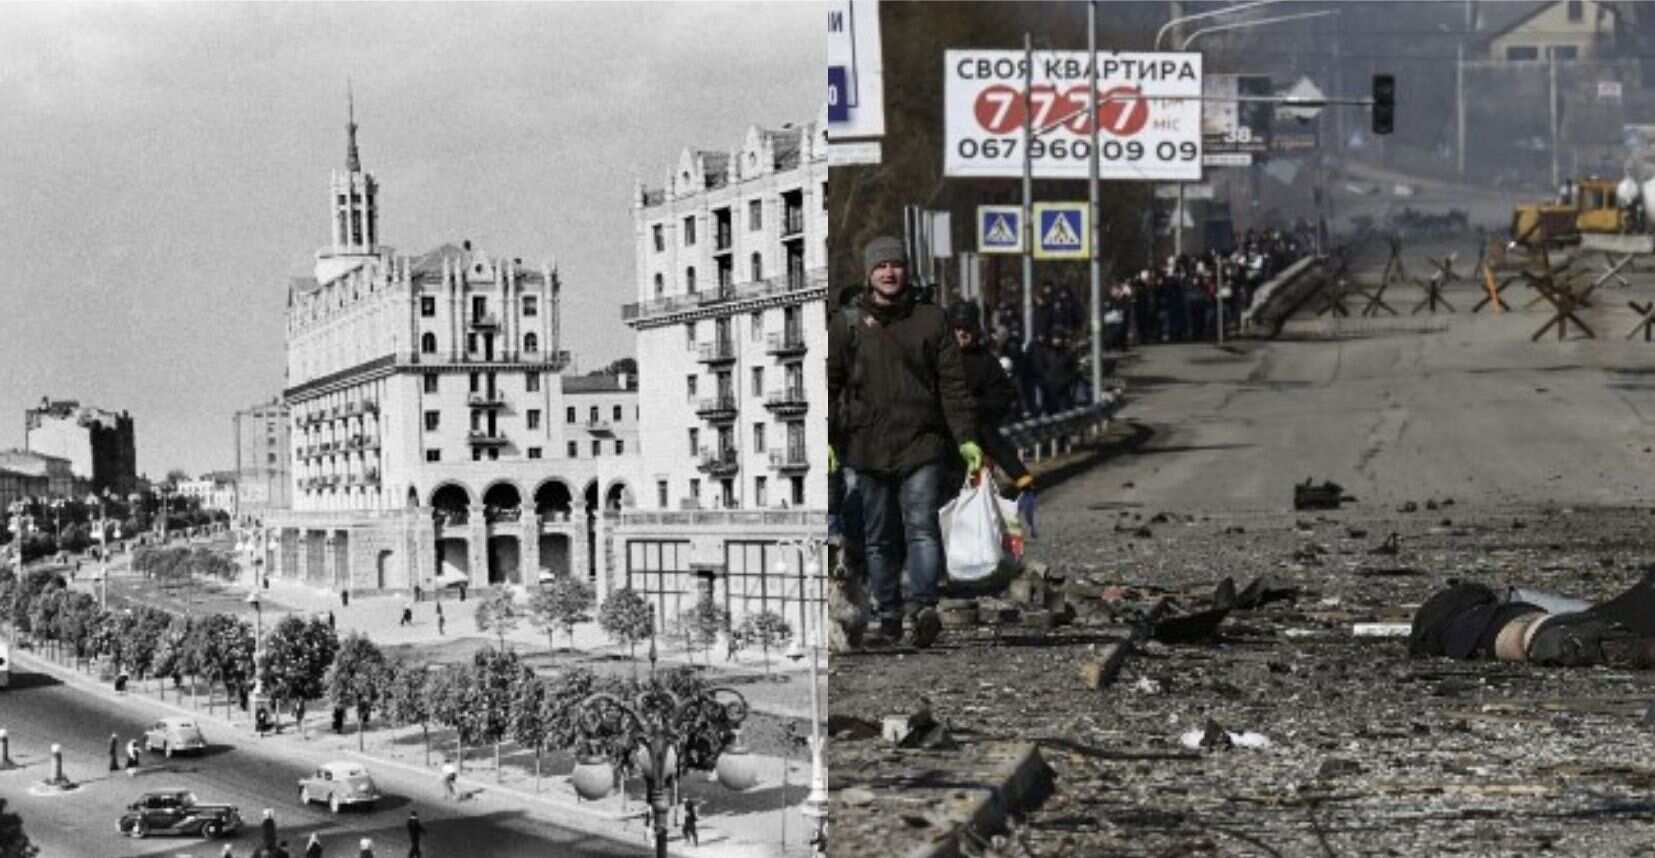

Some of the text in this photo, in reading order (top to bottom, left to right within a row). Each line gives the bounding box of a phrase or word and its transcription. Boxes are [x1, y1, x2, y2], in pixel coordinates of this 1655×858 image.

[957, 58, 1031, 79] СВОЯ
[958, 138, 1017, 159] 067
[1027, 138, 1091, 160] 960
[1103, 141, 1145, 161] 09
[1156, 141, 1198, 161] 09
